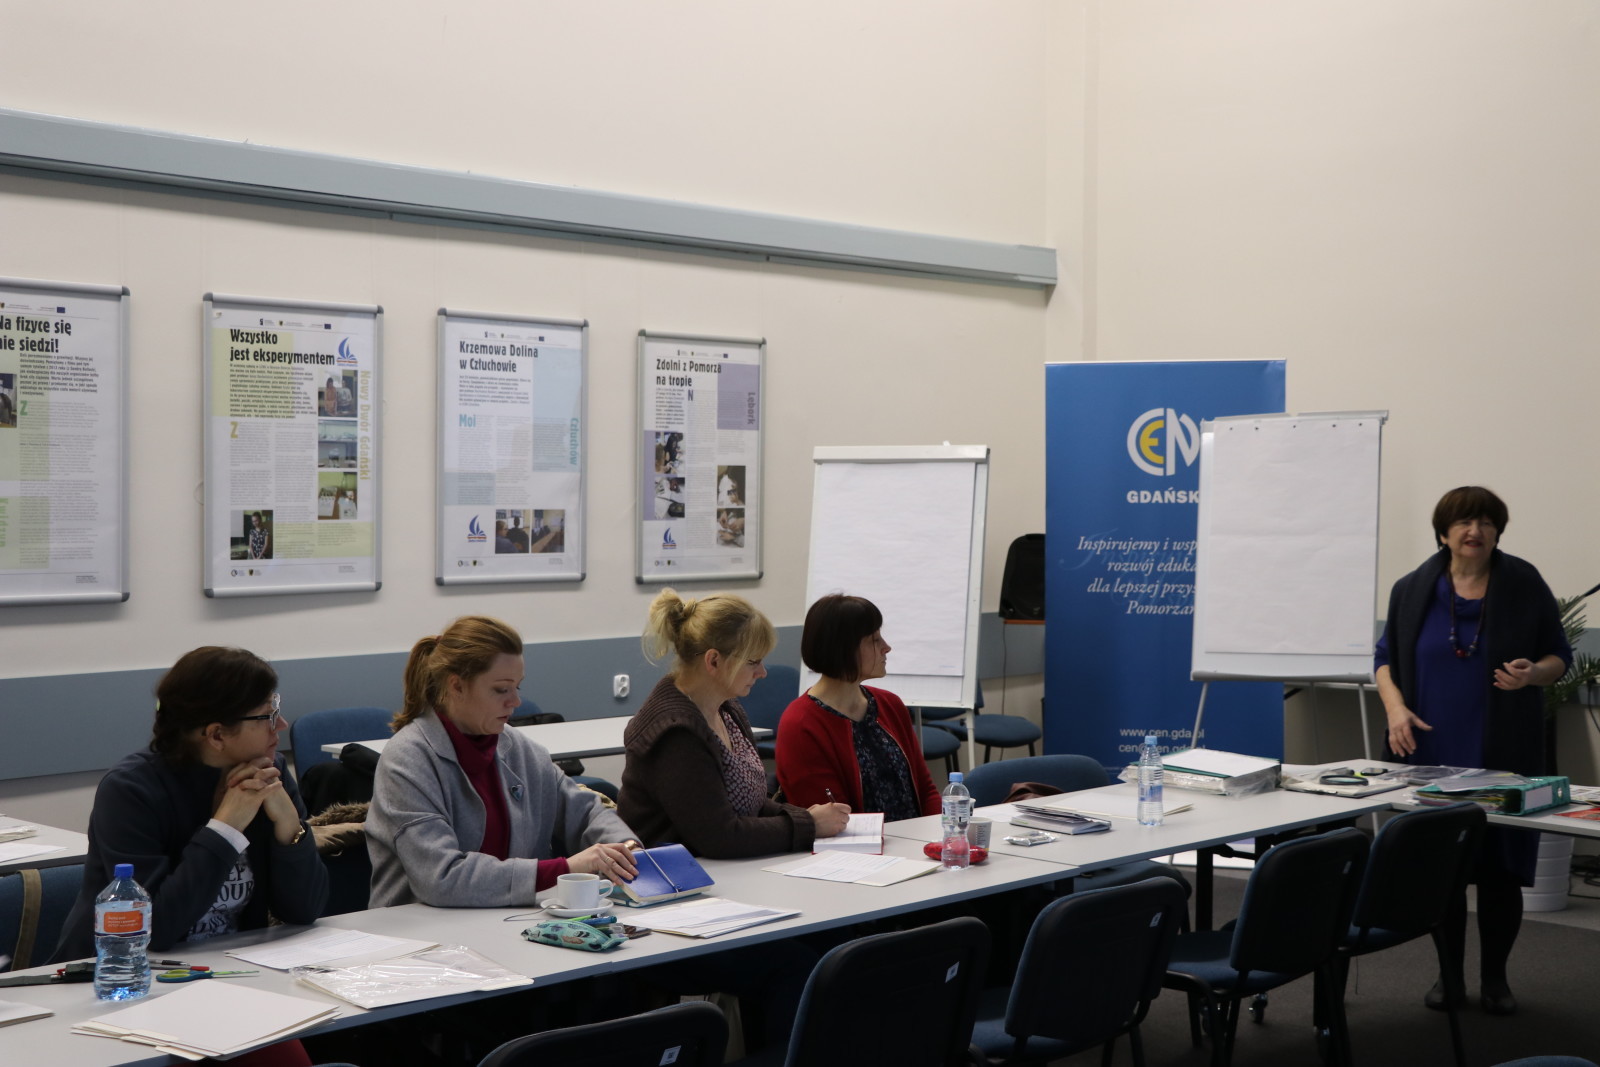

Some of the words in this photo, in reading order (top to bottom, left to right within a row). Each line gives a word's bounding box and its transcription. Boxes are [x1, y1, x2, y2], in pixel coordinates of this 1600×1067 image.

[16, 316, 51, 334] fizyce
[54, 319, 72, 336] się
[19, 337, 59, 353] siedzi!
[230, 328, 278, 346] Wszystko
[229, 347, 250, 362] jest
[253, 349, 335, 366] eksperymentem
[459, 340, 507, 356] Krzemowa
[510, 344, 539, 358] Dolina
[459, 360, 467, 370] w
[469, 358, 517, 373] Człuchowie
[656, 358, 681, 372] Zdolni
[689, 360, 722, 373] Pomorza
[360, 369, 371, 401] Nowy
[656, 376, 666, 385] na
[669, 375, 692, 387] tropie
[360, 403, 371, 432] Dwór
[747, 392, 756, 424] Lębork
[459, 414, 476, 428] Moi
[360, 435, 371, 480] Gdański
[1127, 487, 1200, 504] GDAŃSK
[1077, 536, 1160, 555] Inspirujemy
[1163, 537, 1170, 550] i
[1107, 557, 1154, 576] rozwój
[1087, 578, 1110, 592] dla
[1113, 578, 1159, 597] lepszej
